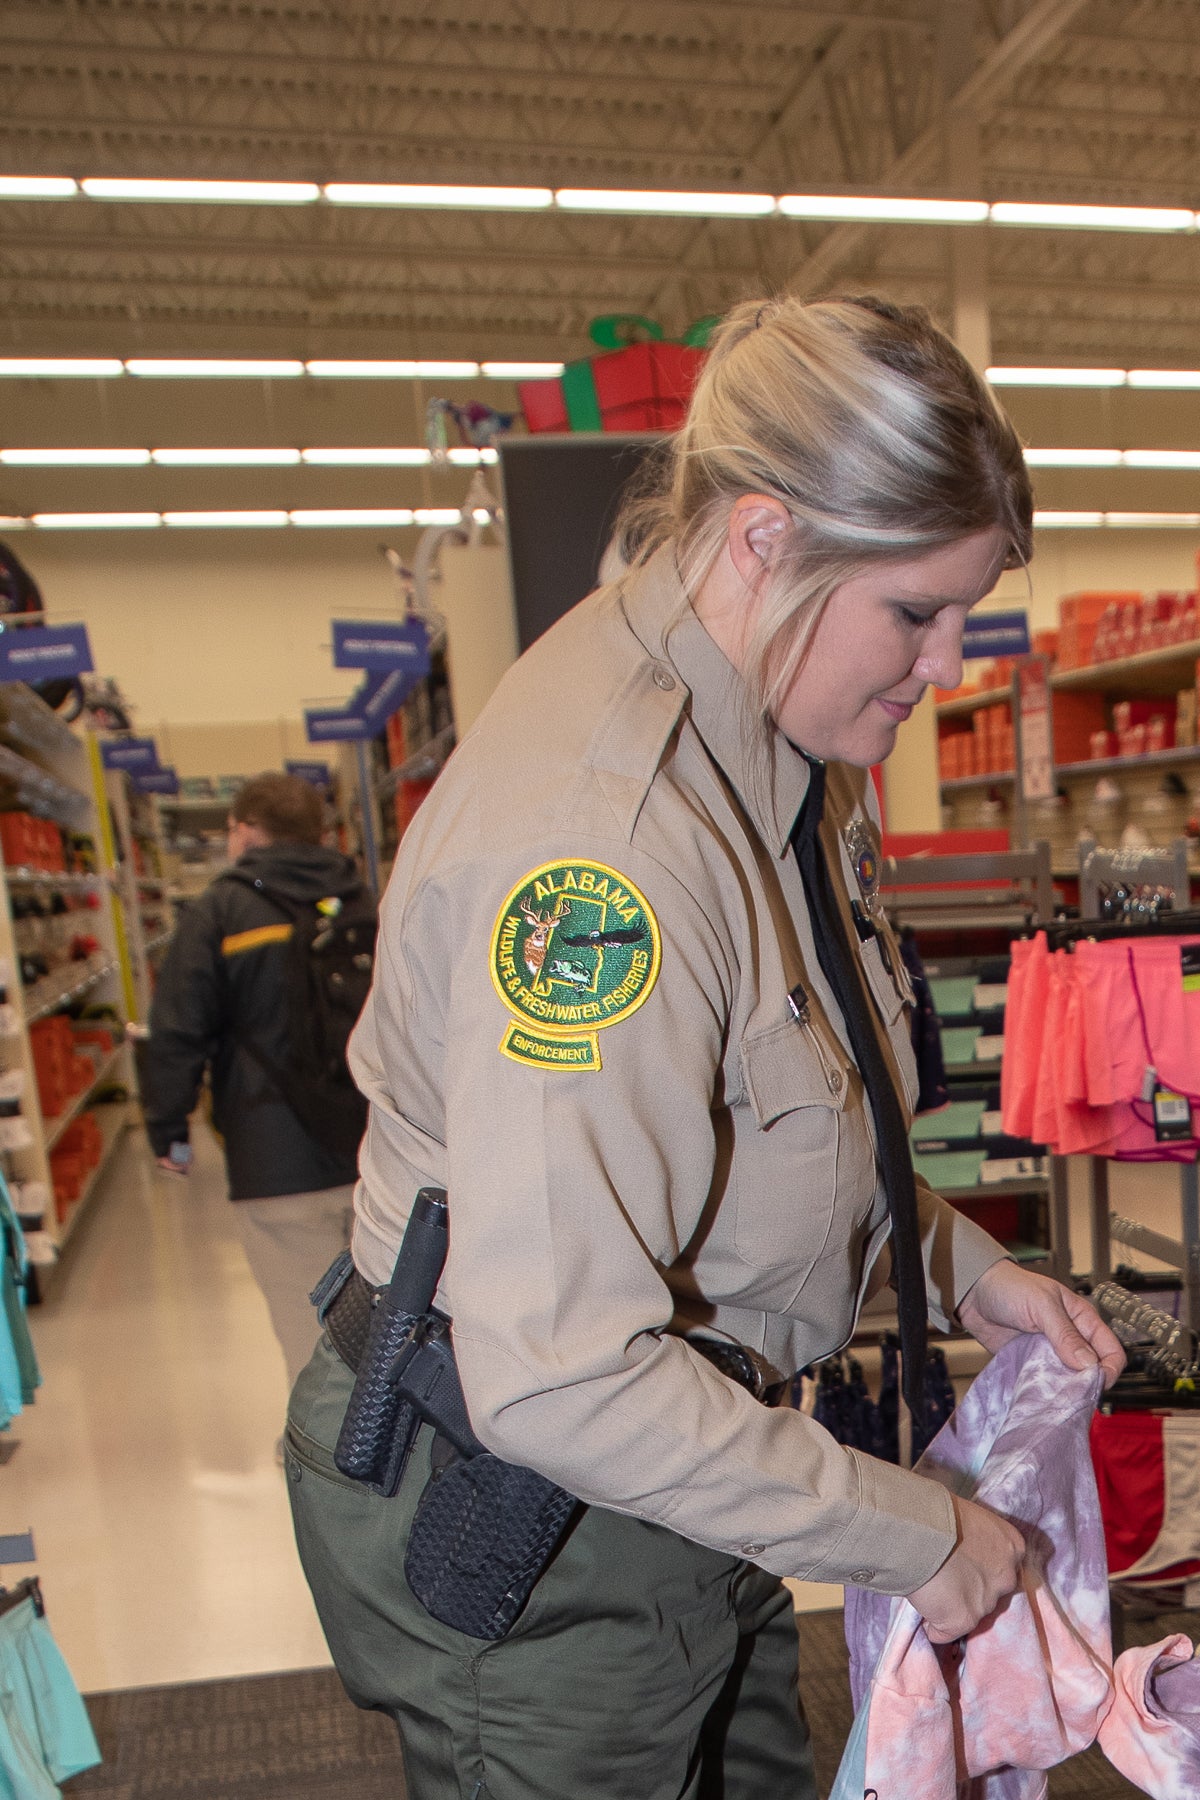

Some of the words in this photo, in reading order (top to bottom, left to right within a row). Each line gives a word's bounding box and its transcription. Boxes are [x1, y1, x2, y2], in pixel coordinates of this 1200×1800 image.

[534, 869, 640, 924] ALABAMA
[498, 915, 521, 978] WILDLIFE
[506, 977, 522, 993] &
[514, 985, 603, 1021] FRESHWATER
[603, 949, 649, 1012] FISHERIES
[512, 1034, 589, 1061] ENFORCEMENT
